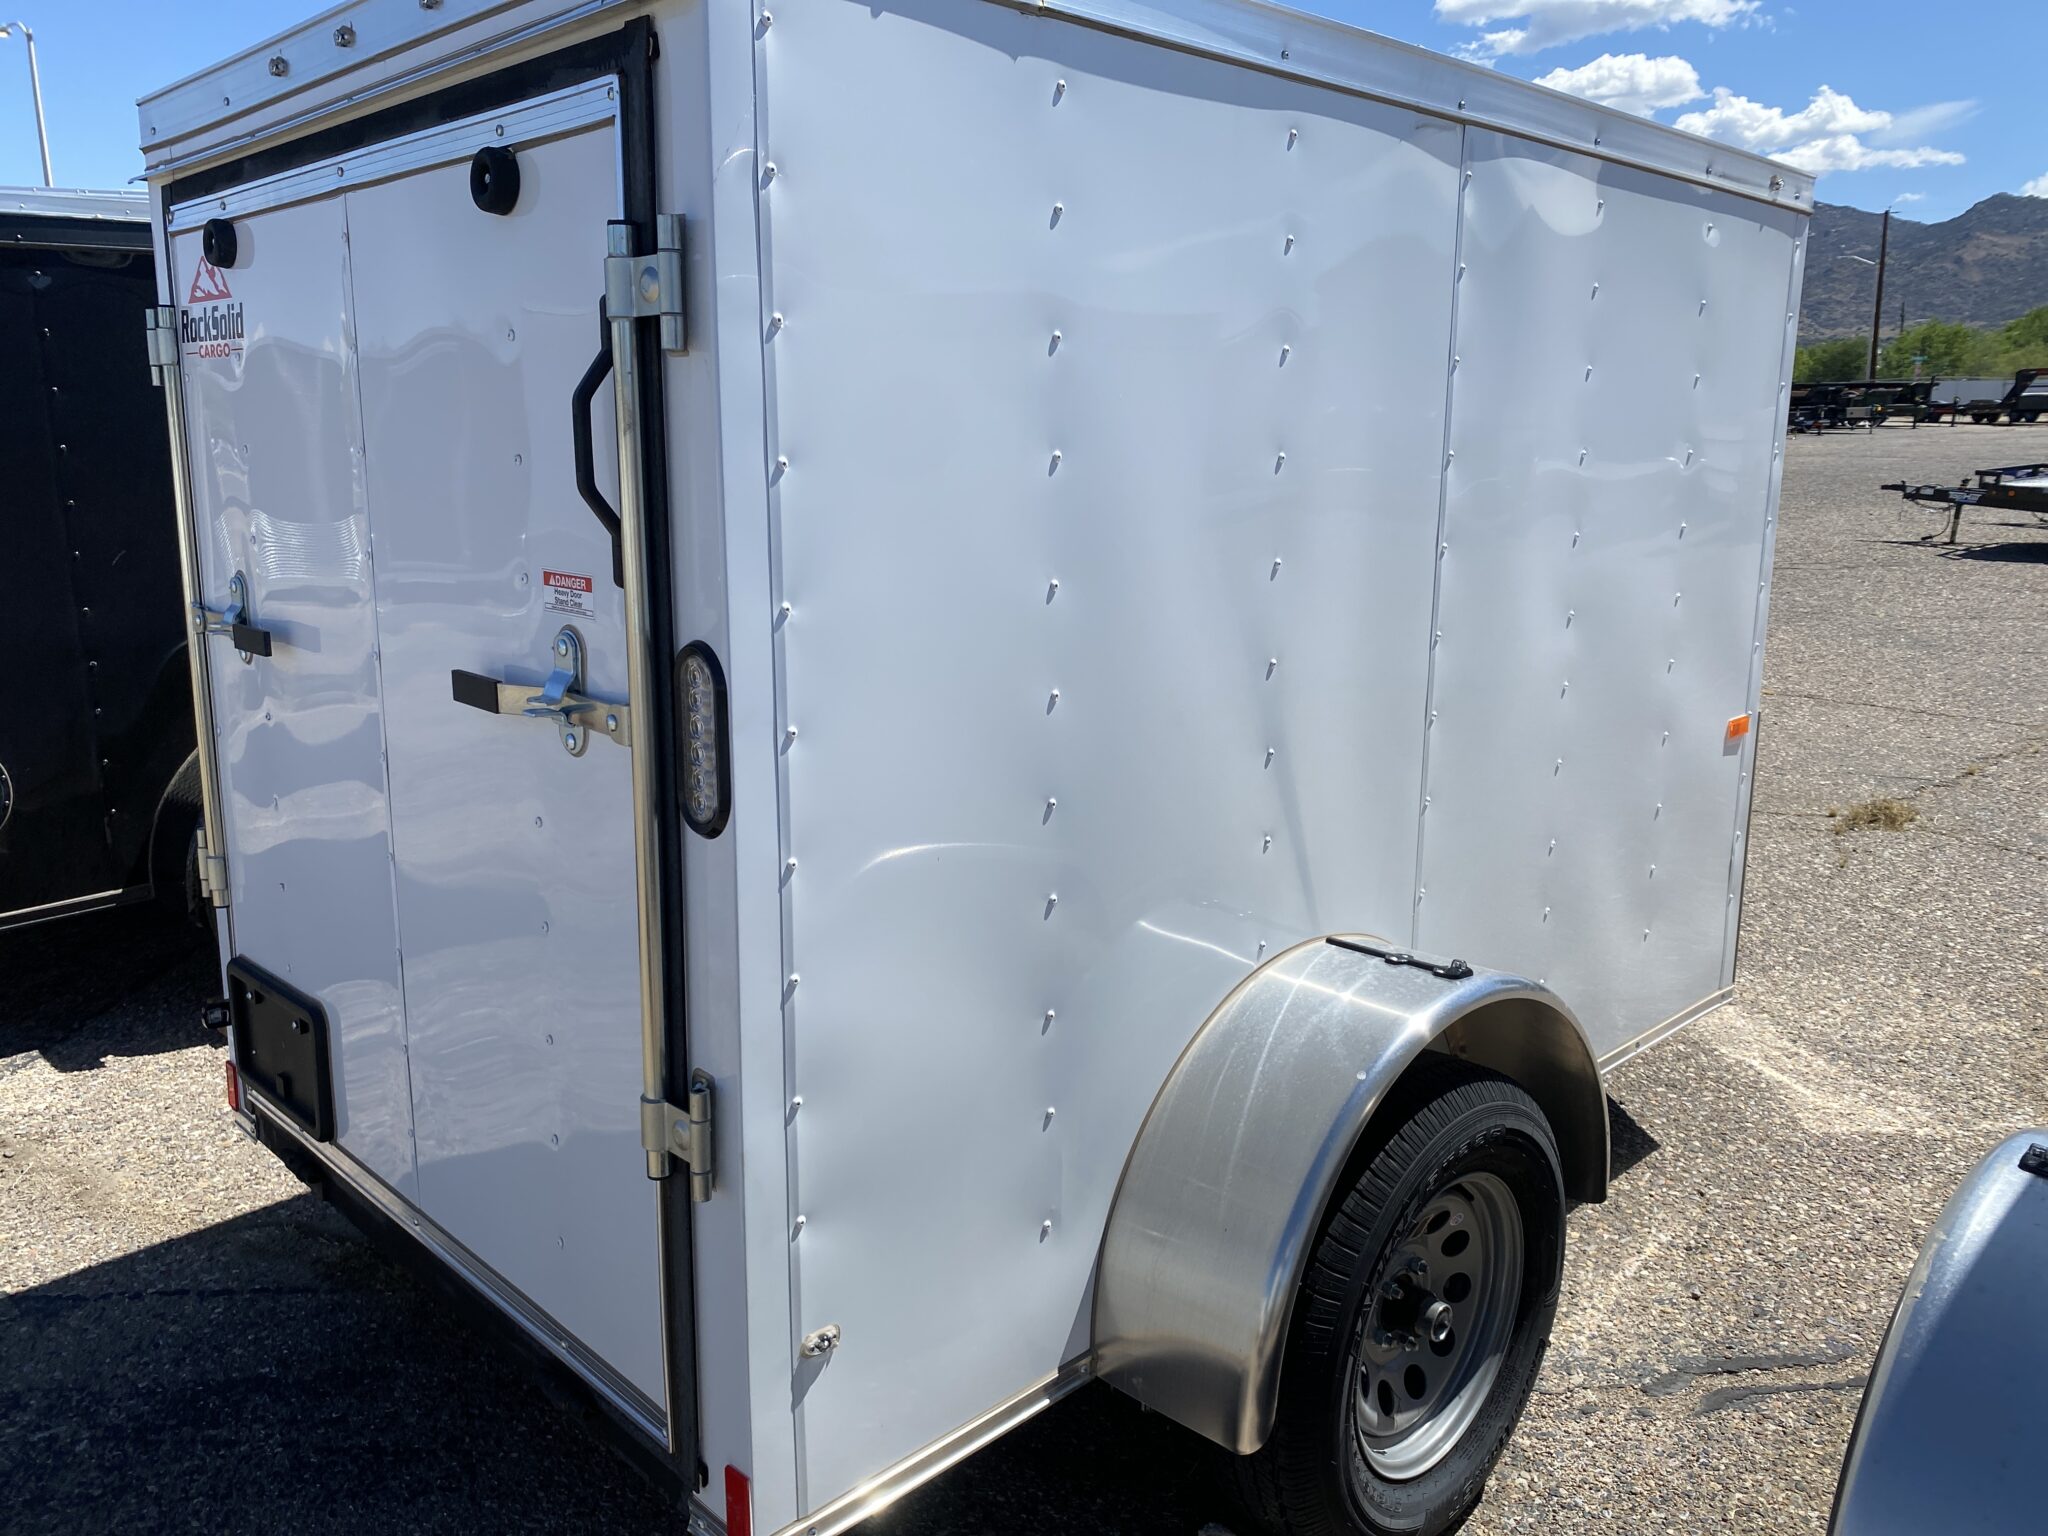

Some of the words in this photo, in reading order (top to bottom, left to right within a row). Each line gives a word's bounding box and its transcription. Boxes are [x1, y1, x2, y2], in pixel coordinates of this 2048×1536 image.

[181, 302, 244, 343] RockSolid
[199, 343, 231, 358] CARGO
[555, 575, 586, 590] DANGER
[554, 588, 569, 598] Heavy
[570, 590, 582, 599] Door
[554, 596, 569, 606] Stand
[570, 599, 583, 608] Clear
